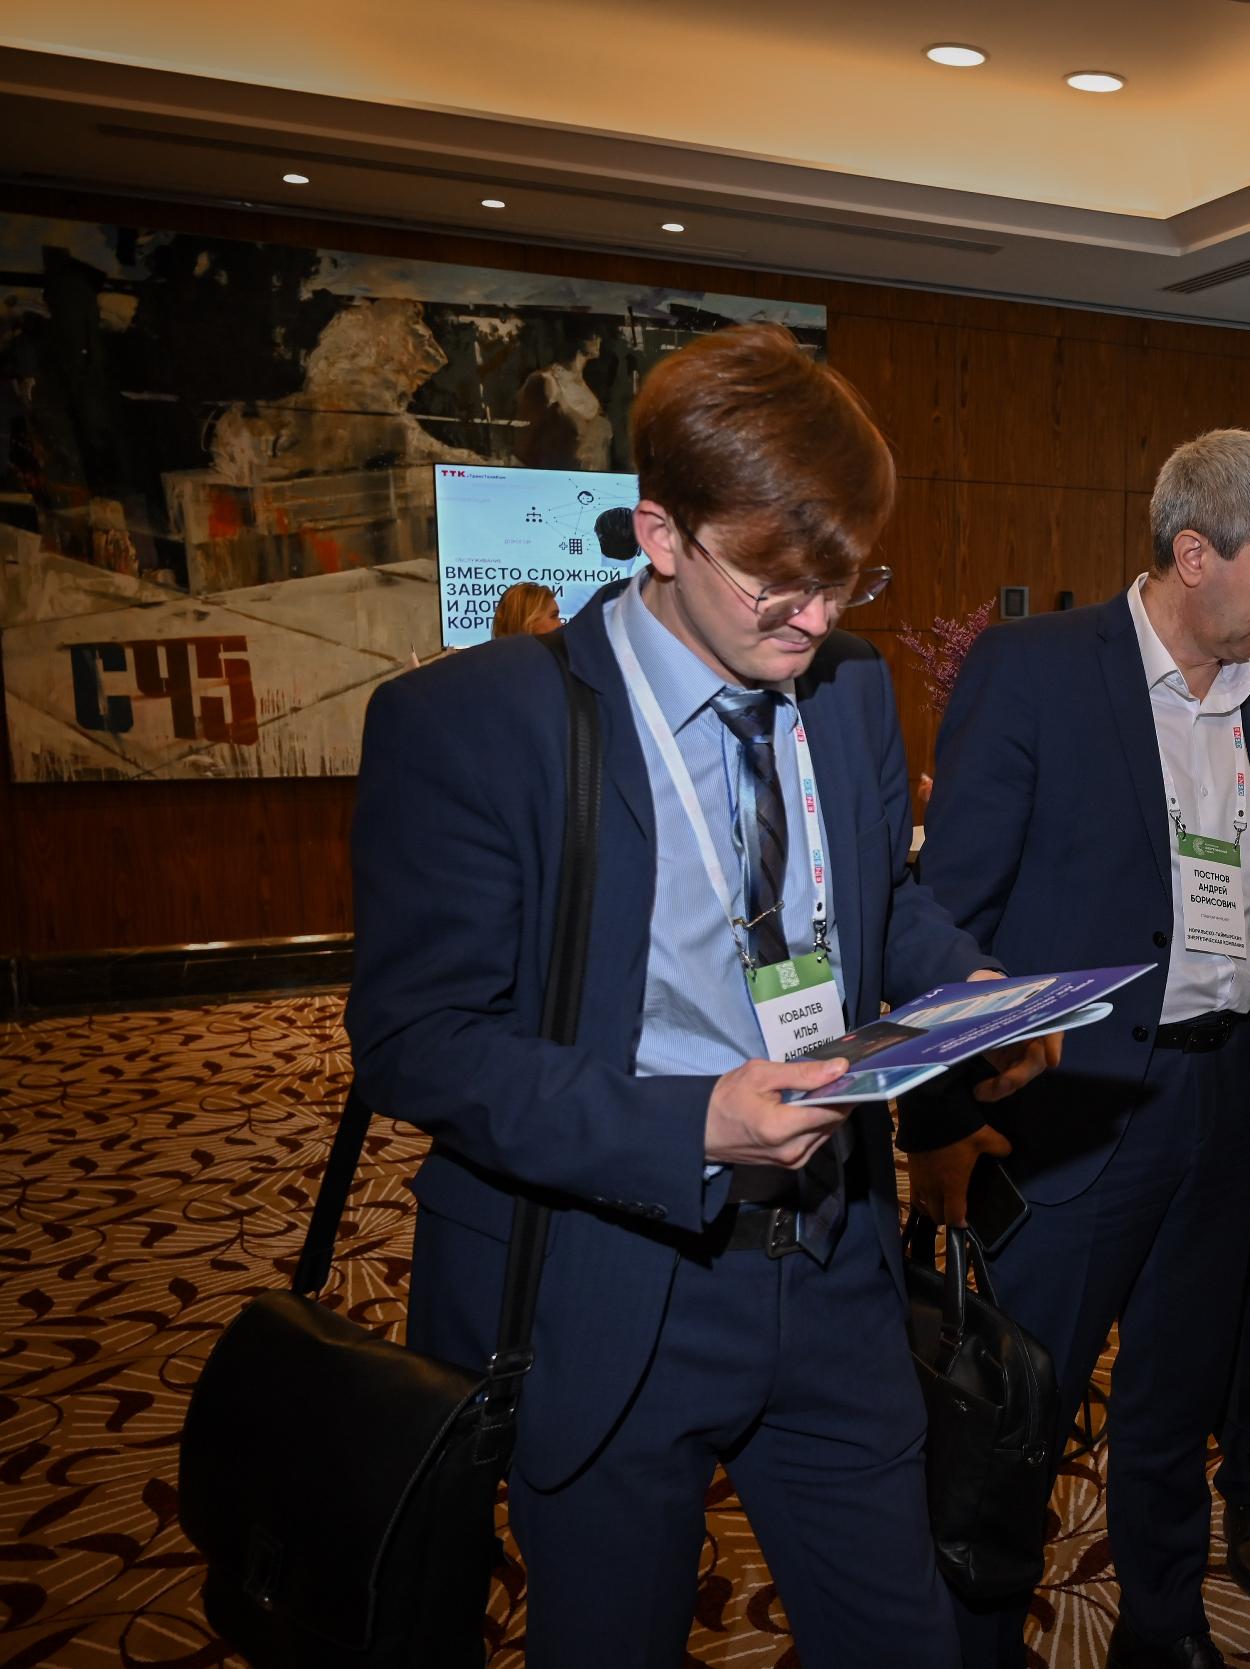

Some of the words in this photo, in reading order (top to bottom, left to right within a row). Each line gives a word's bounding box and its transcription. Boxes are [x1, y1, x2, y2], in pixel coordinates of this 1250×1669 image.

[441, 469, 466, 478] ТТК
[445, 566, 522, 580] ВМЕСТО
[527, 567, 621, 583] СЛОЖНОЙ
[447, 600, 459, 612] И
[1194, 869, 1230, 883] ПОСТНОВ
[1198, 882, 1228, 895] АНДРЕЙ
[1190, 894, 1237, 910] БОРИСОВИЧ
[778, 1002, 824, 1025] КОВАЛЕВ
[793, 1022, 819, 1040] ИЛЬЯ
